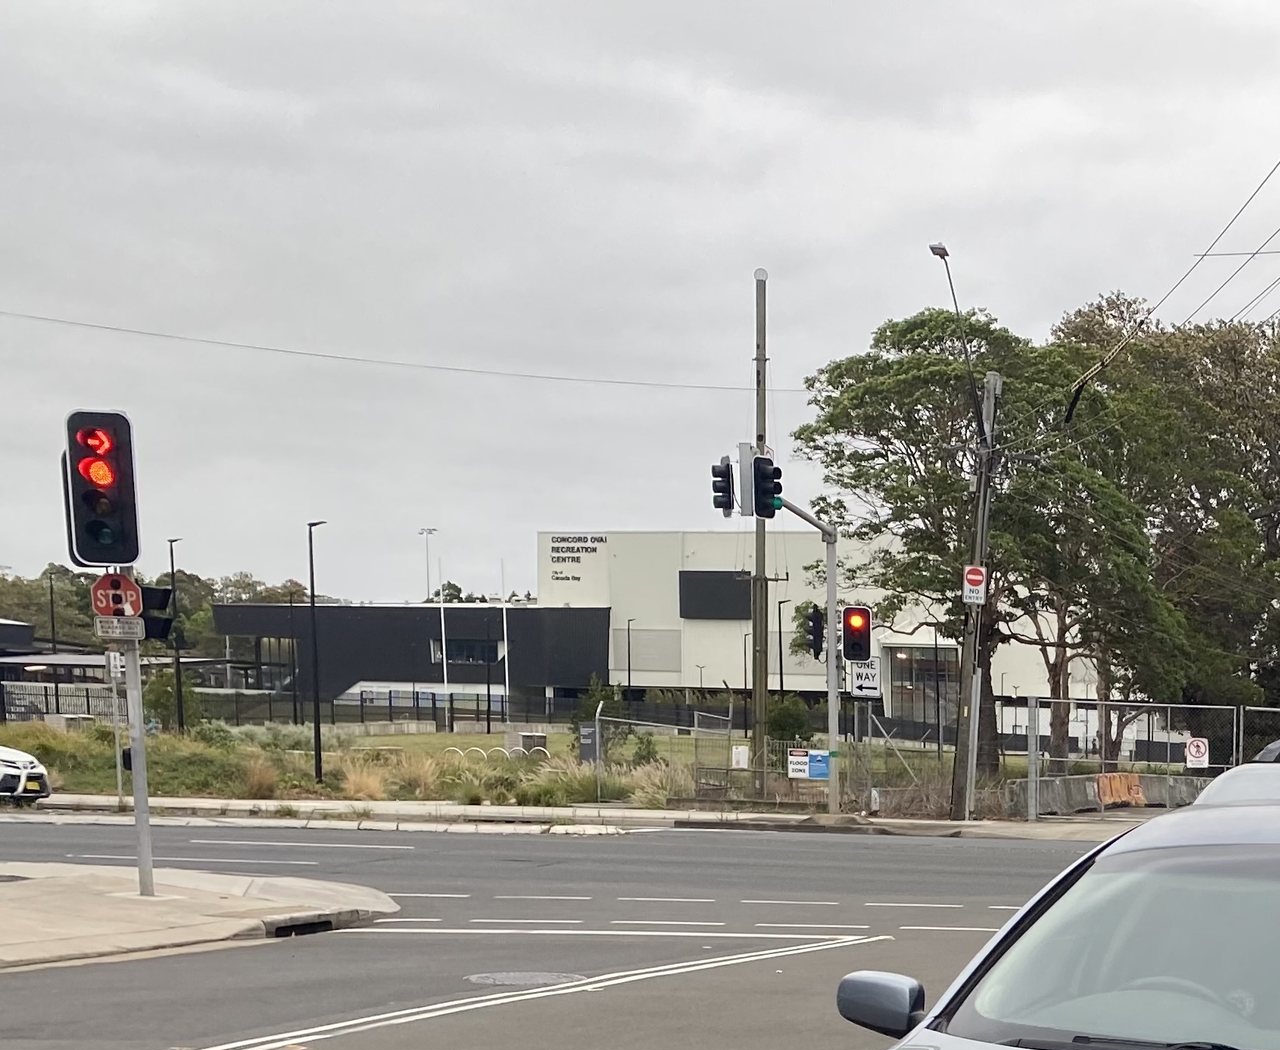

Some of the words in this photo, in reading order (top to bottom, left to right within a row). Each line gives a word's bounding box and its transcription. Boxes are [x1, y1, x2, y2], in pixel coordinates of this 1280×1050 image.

[97, 589, 137, 608] STOP
[856, 662, 877, 670] ONE
[855, 672, 877, 682] WAY
